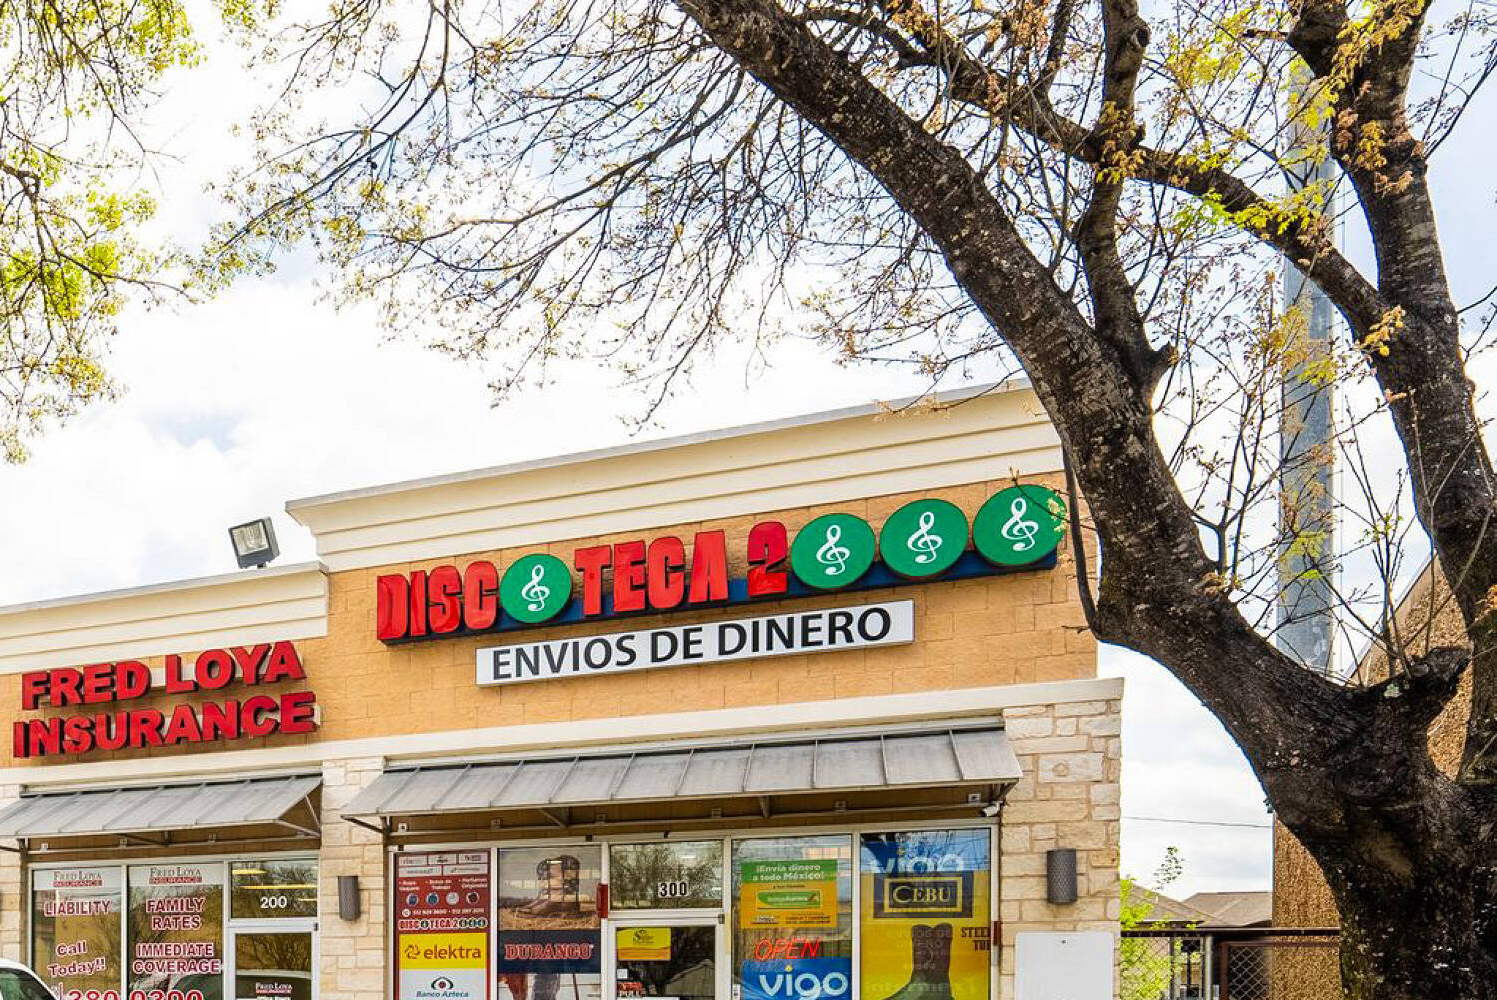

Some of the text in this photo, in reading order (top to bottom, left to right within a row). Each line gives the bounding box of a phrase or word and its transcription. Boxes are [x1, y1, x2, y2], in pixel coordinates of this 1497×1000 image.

[492, 607, 892, 682] ENVIOS DE DINERO
[22, 640, 307, 710] FRED LOYA
[13, 691, 317, 758] INSURANCE
[659, 882, 688, 897] 300
[44, 900, 111, 916] LIABILITY
[146, 898, 205, 914] FAMILY
[260, 896, 288, 909] 200
[152, 915, 202, 930] RATES
[56, 940, 87, 957] Call
[136, 943, 214, 957] IMMEDIATE
[423, 944, 481, 959] elektra
[504, 943, 592, 960] DURANGO
[755, 939, 820, 960] OPEN
[47, 957, 106, 977] Today!!
[133, 959, 222, 974] COVERAGE
[416, 990, 469, 998] Banco Azteca
